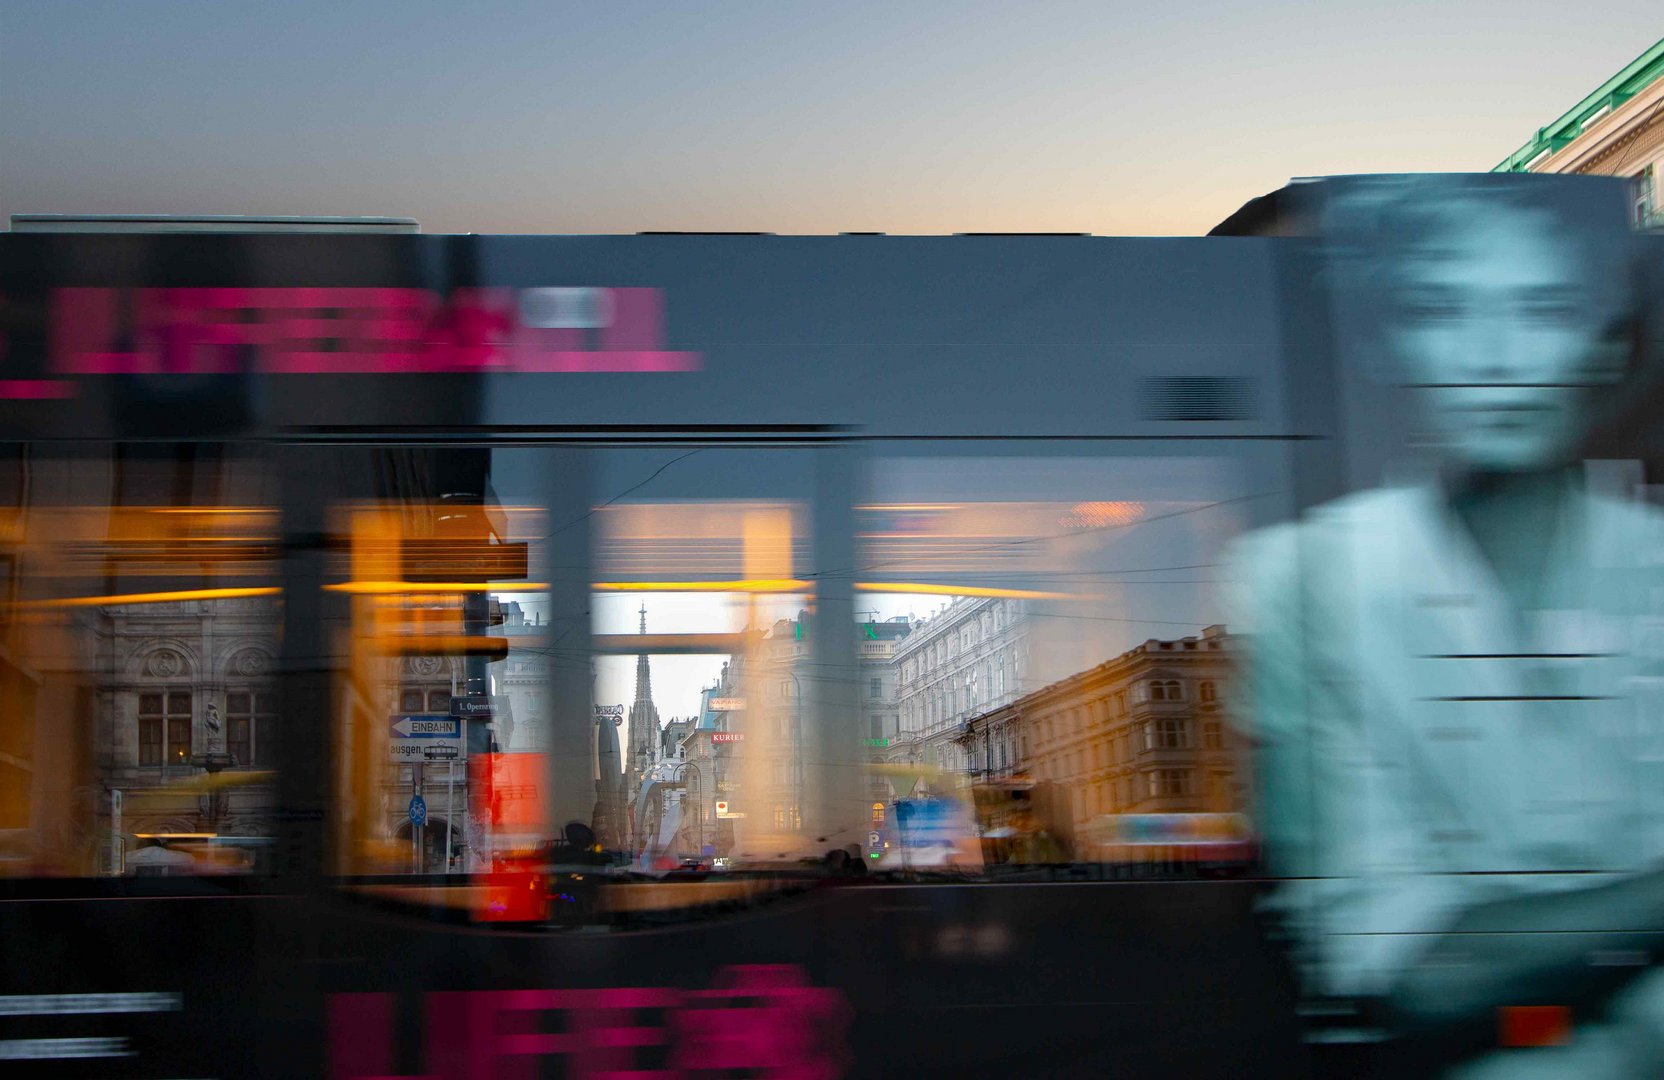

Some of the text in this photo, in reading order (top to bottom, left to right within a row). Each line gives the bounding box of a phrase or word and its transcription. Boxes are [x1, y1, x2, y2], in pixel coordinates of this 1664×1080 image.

[466, 702, 499, 712] Opernring
[411, 722, 453, 732] EINBAHN
[390, 744, 424, 756] ausgen.
[868, 832, 880, 847] P
